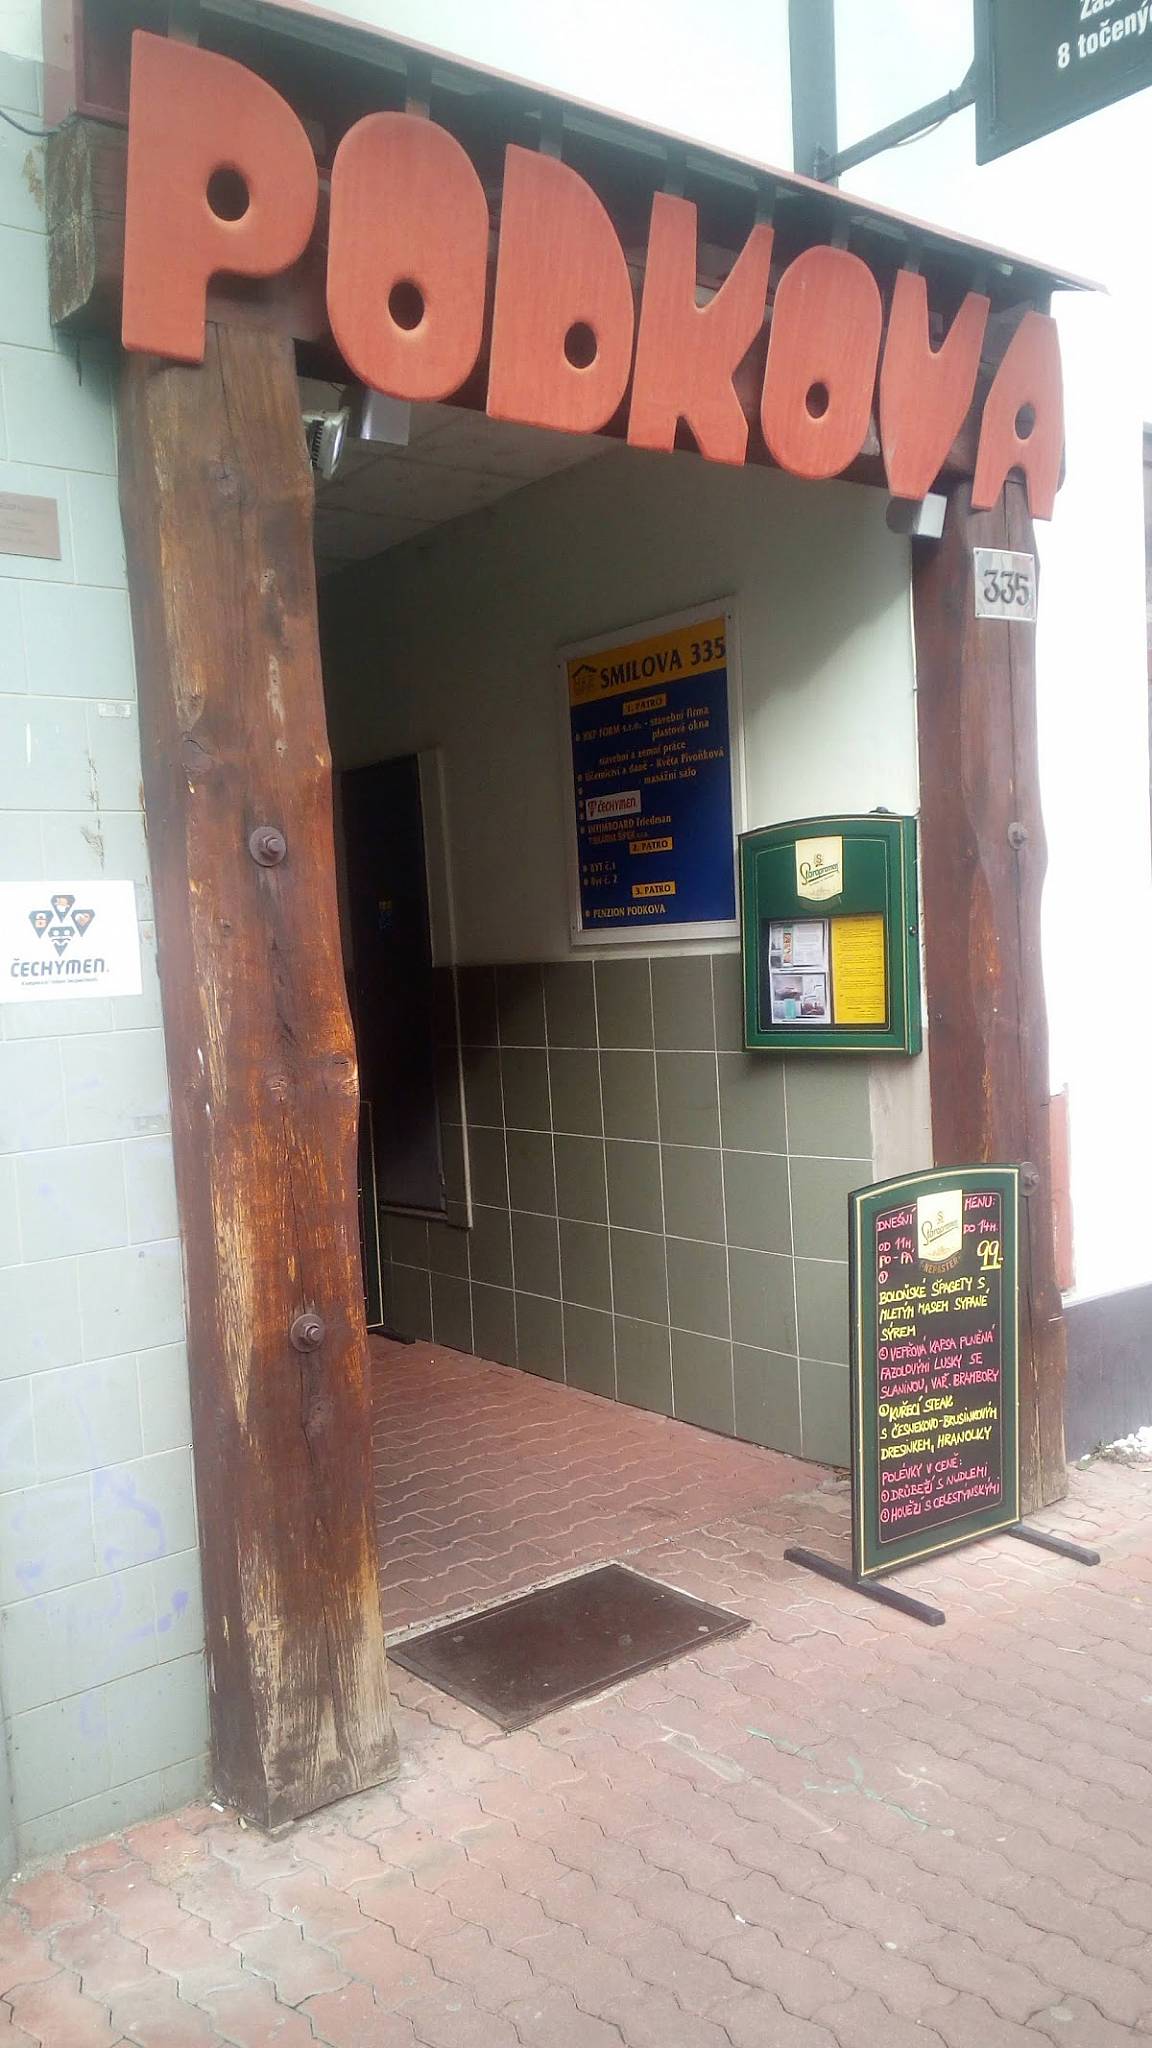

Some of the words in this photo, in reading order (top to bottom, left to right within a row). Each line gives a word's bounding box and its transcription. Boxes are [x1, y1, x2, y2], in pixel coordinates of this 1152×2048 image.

[1058, 42, 1070, 68] 8
[1078, 0, 1152, 57] točený
[122, 29, 1065, 520] PODKOVA
[984, 570, 1030, 606] 335
[600, 649, 682, 689] SMILOVA
[691, 636, 727, 666] 335
[636, 697, 663, 711] PATRO
[686, 706, 709, 720] firma
[688, 718, 710, 733] okna
[641, 839, 669, 851] PATRO
[644, 883, 671, 895] PATRO
[593, 906, 625, 919] PENZION
[627, 904, 666, 917] PODKOVA
[877, 1207, 917, 1232] DNEŠNÍ
[964, 1196, 996, 1211] MENU:
[878, 1242, 891, 1252] OD
[964, 1224, 976, 1235] DO
[931, 1276, 973, 1298] ŠPAGETY
[977, 1276, 986, 1290] S
[879, 1301, 915, 1324] MLETÝM
[918, 1300, 949, 1315] MASEM
[953, 1287, 990, 1311] SYPANÉ
[880, 1321, 916, 1342] SÝREM
[929, 1338, 957, 1354] KAPSA
[934, 1354, 962, 1370] LUSKY
[969, 1352, 983, 1365] SE
[953, 1368, 999, 1388] BRAMBORY
[889, 1395, 924, 1422] KUŘECÍ
[923, 1395, 954, 1413] STEAK
[880, 1428, 888, 1440] S
[937, 1425, 992, 1448] HRANOLKY
[882, 1462, 923, 1486] POLÉVKY
[926, 1463, 932, 1474] V
[936, 1478, 944, 1490] S
[924, 1501, 932, 1512] S
